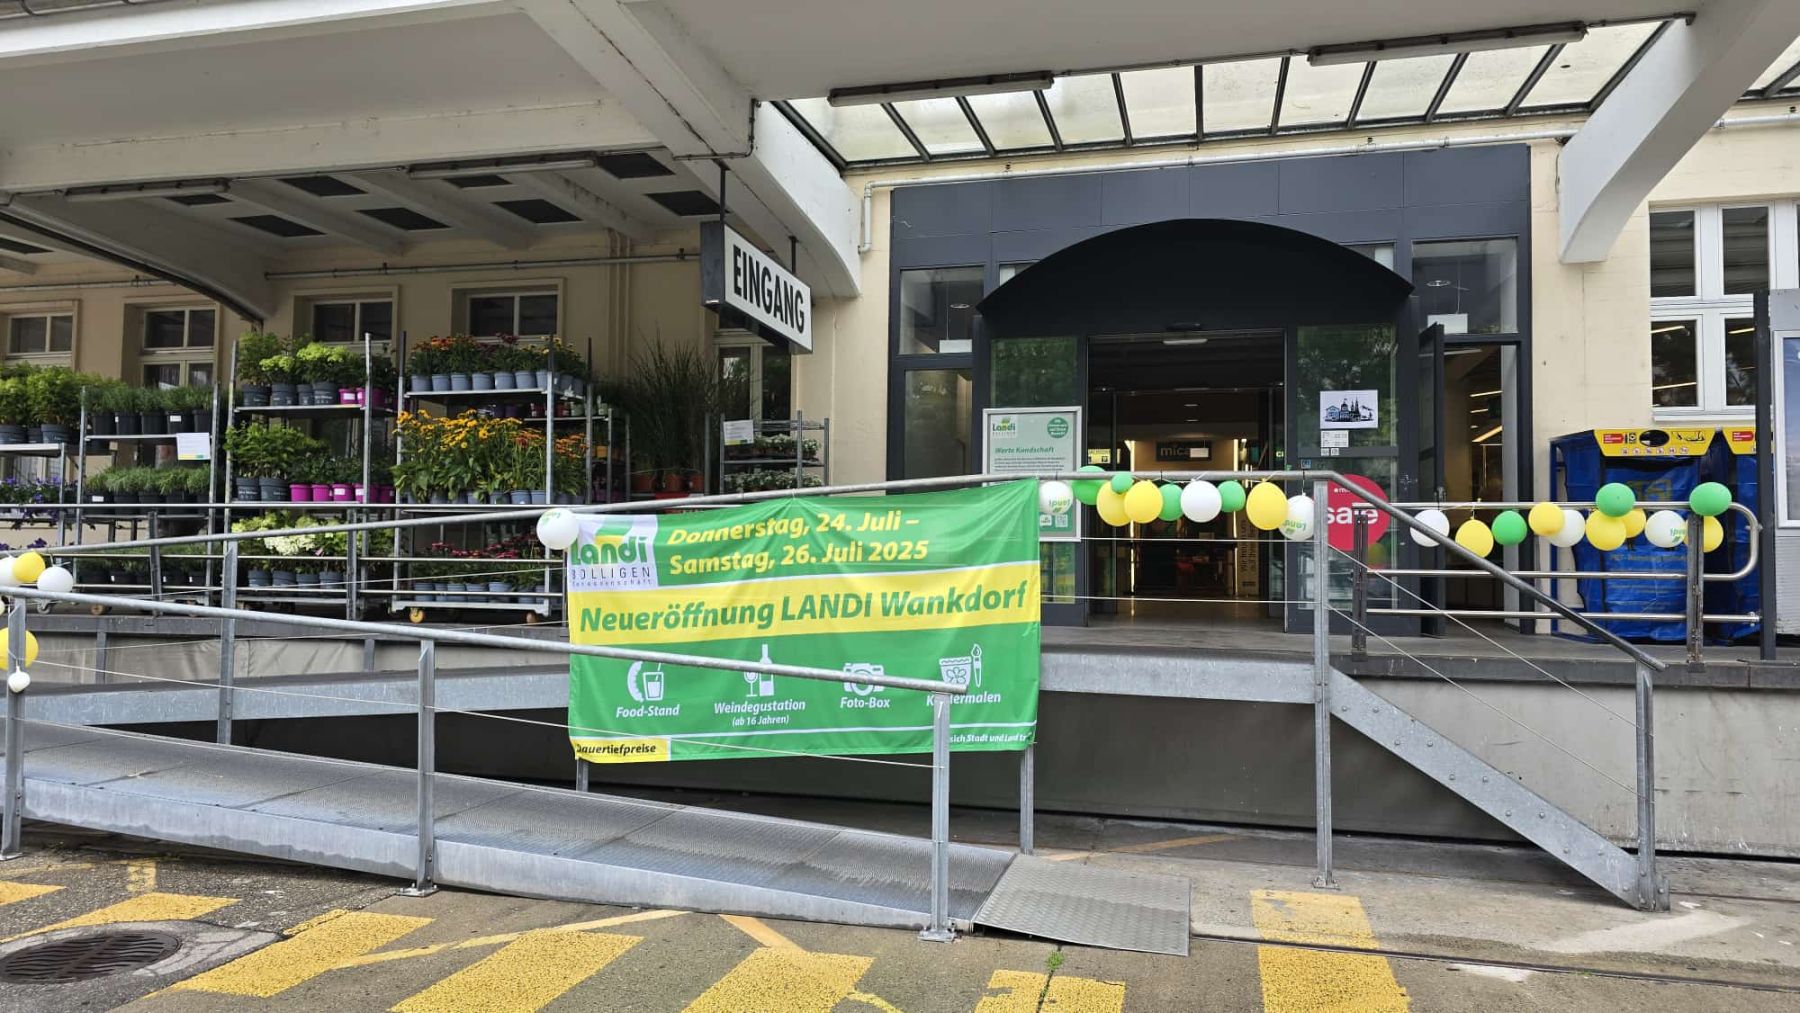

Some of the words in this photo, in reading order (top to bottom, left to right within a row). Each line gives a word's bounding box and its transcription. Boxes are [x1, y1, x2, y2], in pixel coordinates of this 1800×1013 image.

[733, 244, 805, 334] EINGANG
[1327, 506, 1379, 524] sae
[667, 515, 810, 545] Donnerstag,
[816, 512, 852, 533] 24.
[857, 510, 902, 532] Juli
[670, 551, 775, 575] Samstag,
[781, 544, 817, 565] 26.
[822, 540, 863, 563] Juli
[868, 540, 929, 562] 2025
[580, 600, 775, 632] Neueröffnung
[781, 592, 873, 621] LANDI
[881, 580, 1028, 617] Wankdorf
[714, 698, 806, 715] Weindegustation
[840, 696, 891, 709] Foto-Box
[926, 691, 1001, 706] Kermalen
[616, 704, 681, 718] Food-Stand
[732, 716, 745, 728] (ab
[747, 716, 756, 726] 16
[757, 715, 790, 726] Jahren)
